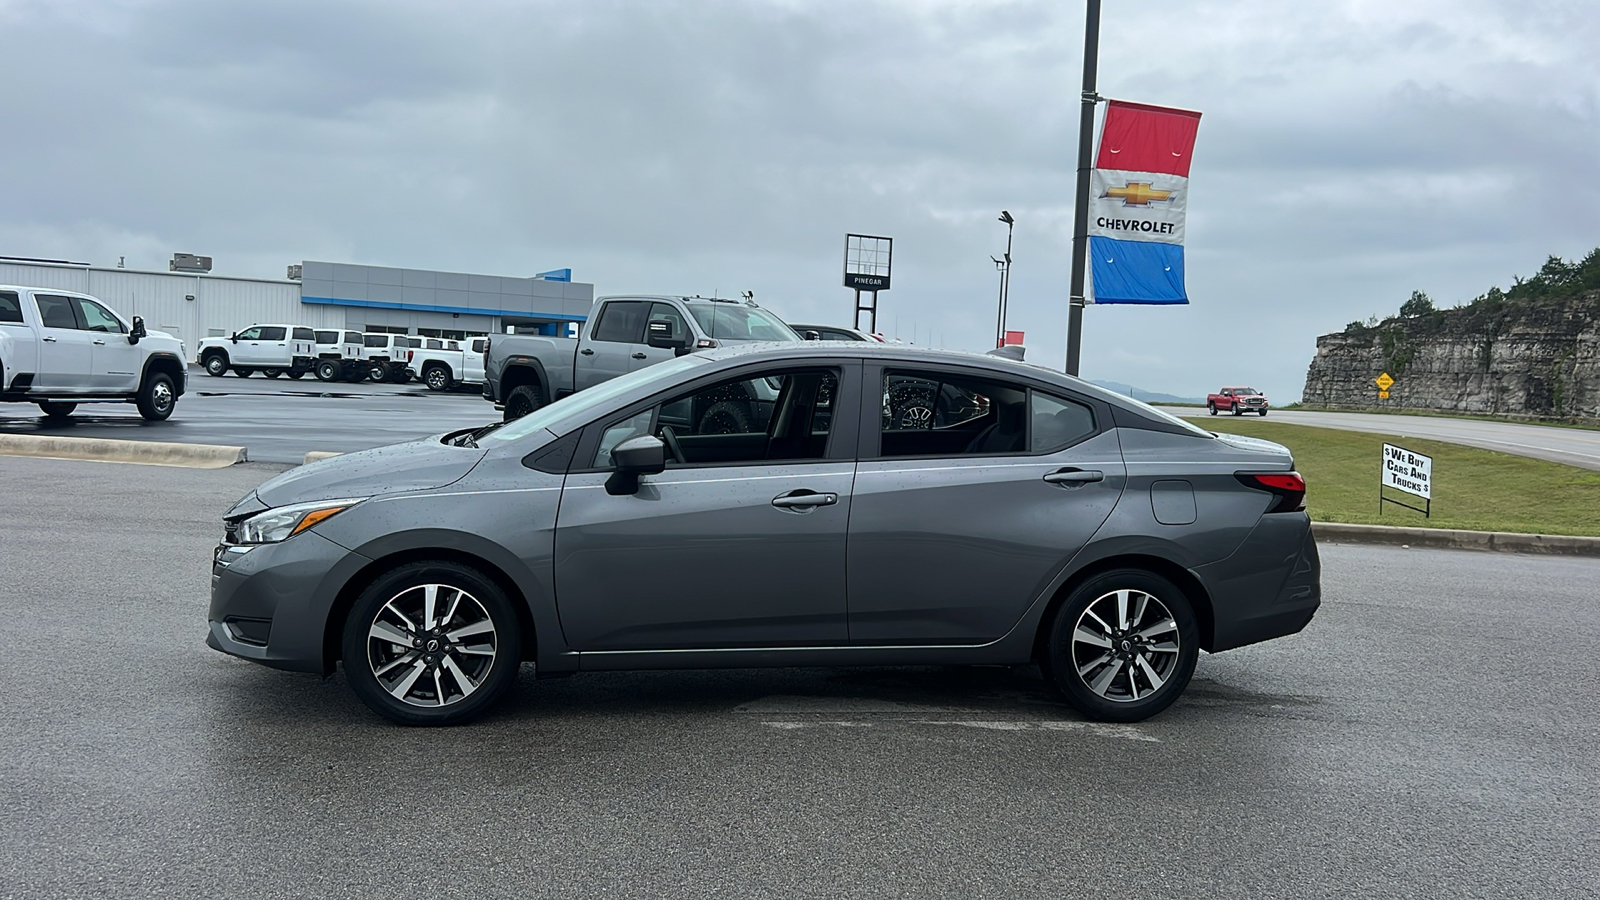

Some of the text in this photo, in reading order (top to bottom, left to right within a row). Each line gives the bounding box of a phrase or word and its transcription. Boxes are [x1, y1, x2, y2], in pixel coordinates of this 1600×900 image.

[1097, 217, 1174, 234] CHEVROLET
[854, 277, 882, 285] PINEGAR
[1408, 454, 1424, 468] BUY
[1387, 460, 1427, 482] CARS AND
[1391, 473, 1421, 492] TRUCKS
